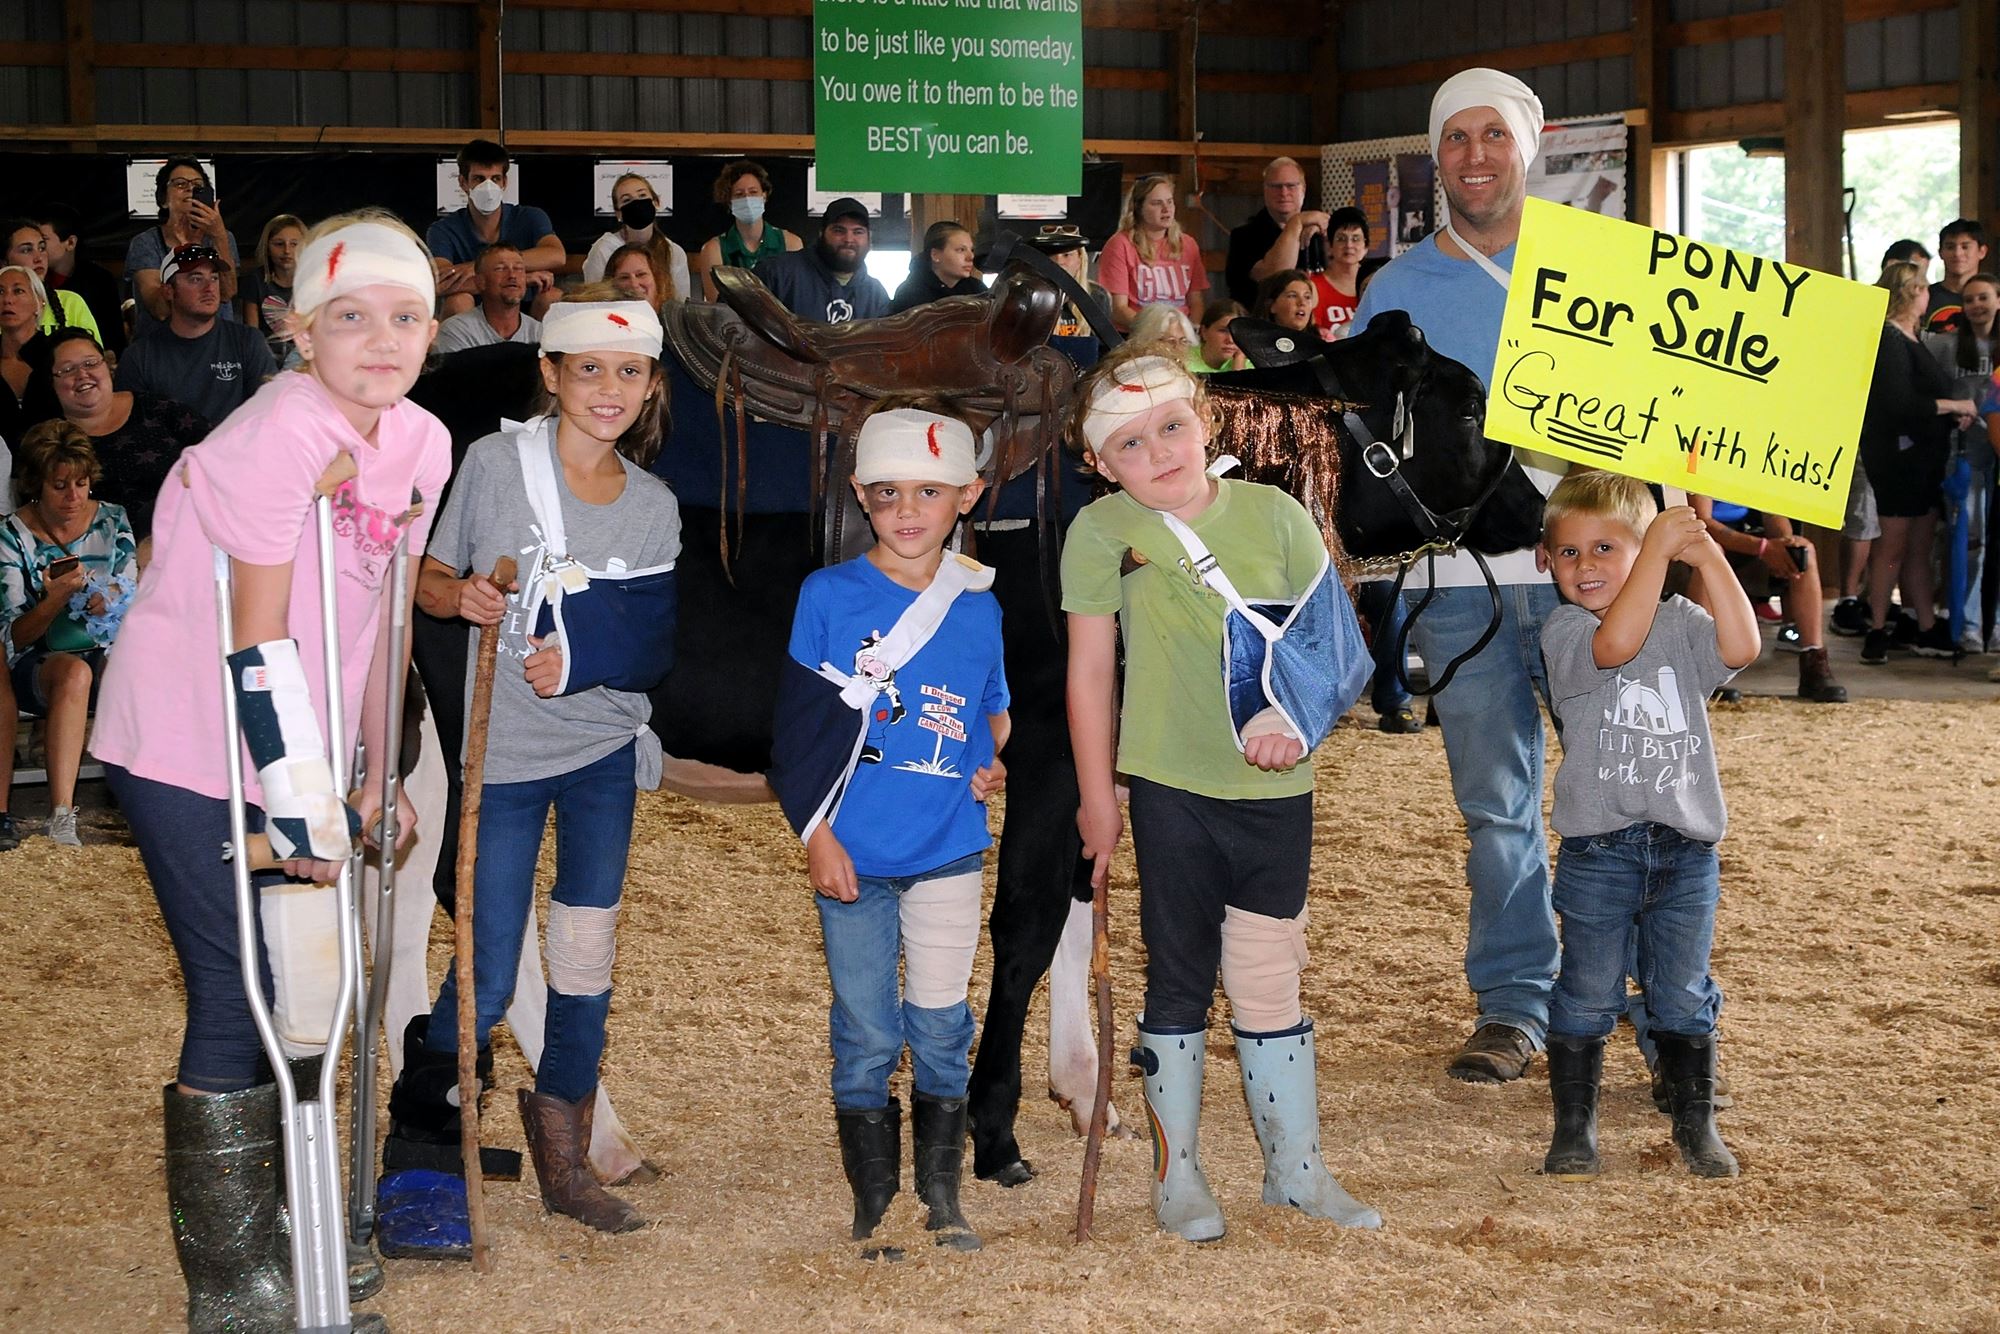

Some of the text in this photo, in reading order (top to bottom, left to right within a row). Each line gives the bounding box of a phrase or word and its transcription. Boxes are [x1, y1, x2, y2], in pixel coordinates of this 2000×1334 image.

[821, 27, 1076, 66] to be just like you someday.
[820, 75, 1078, 108] You owe it to them to be the
[867, 126, 1033, 159] BEST you can be.
[1648, 230, 1811, 318] PONY
[1531, 267, 1780, 377] For Sale
[931, 688, 963, 705] Dressed
[920, 719, 964, 740] CANFIELD FAIR
[949, 718, 962, 730] the
